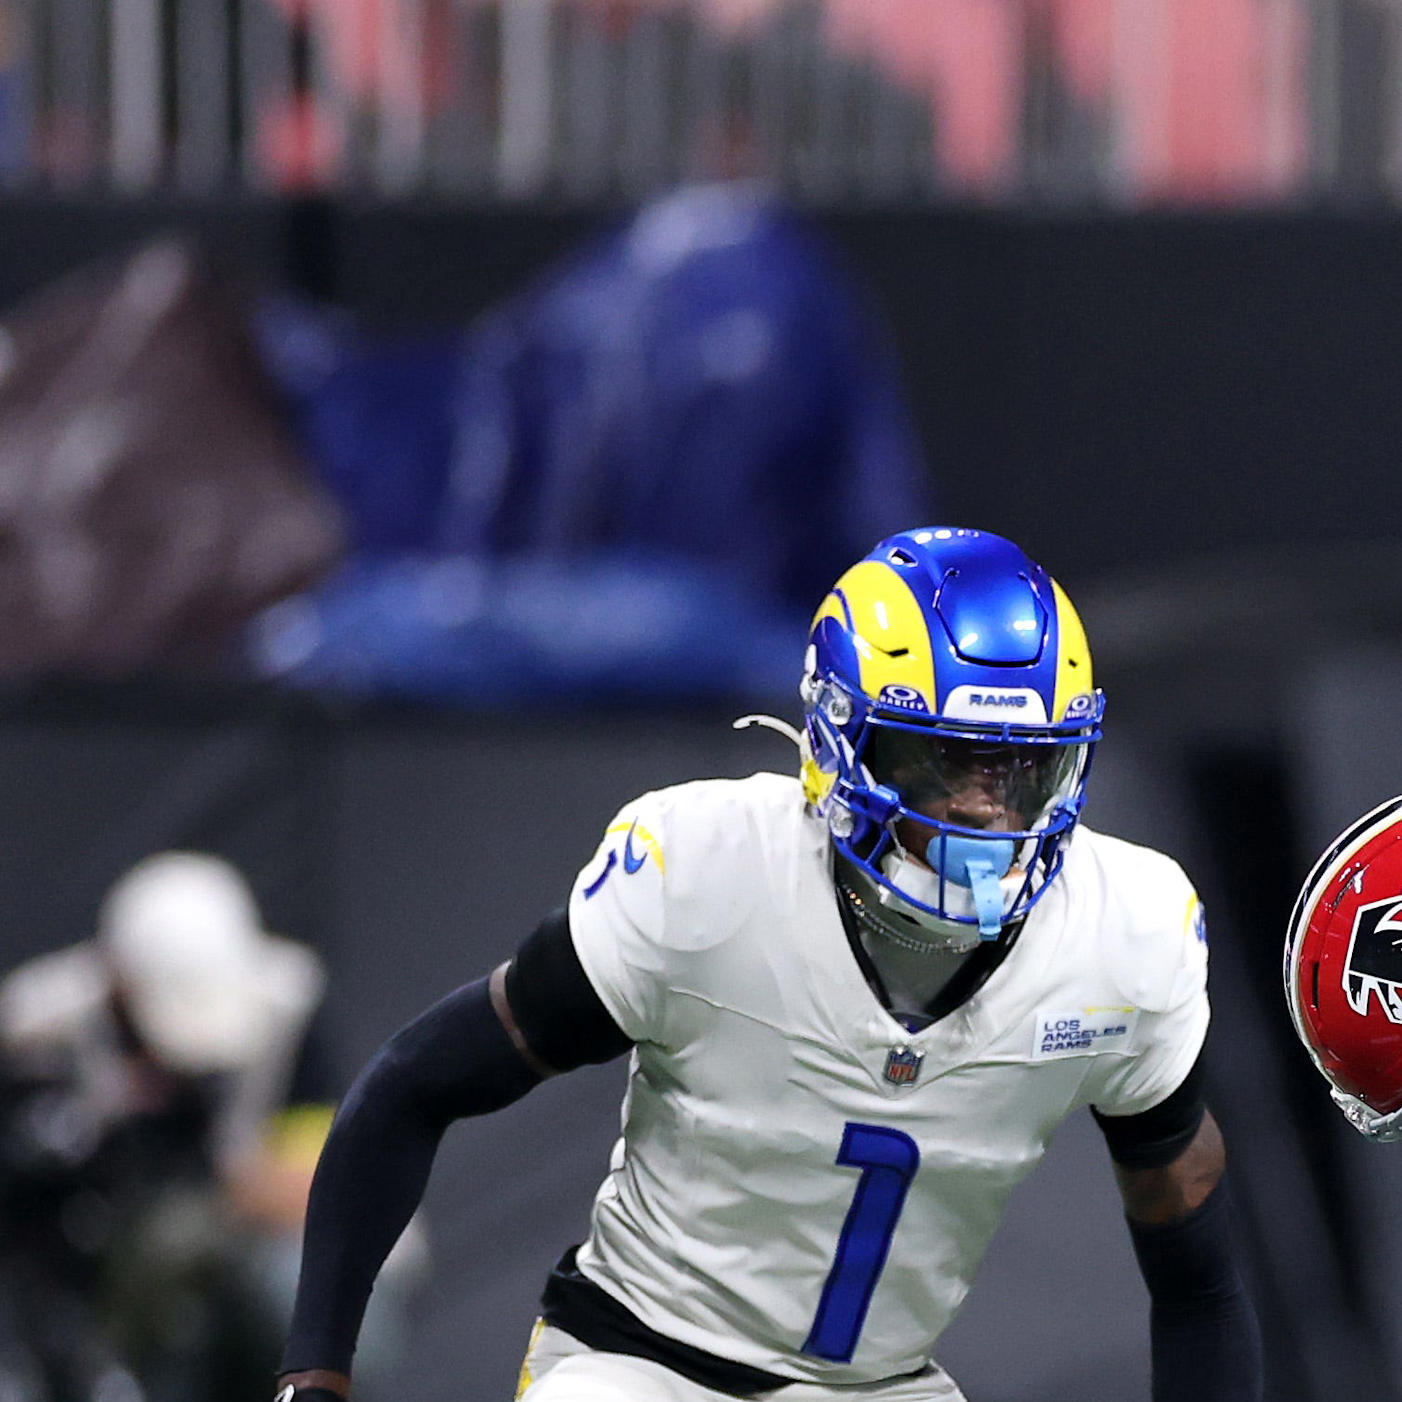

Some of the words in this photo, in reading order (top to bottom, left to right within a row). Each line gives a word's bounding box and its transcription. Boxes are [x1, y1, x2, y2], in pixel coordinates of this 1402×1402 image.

[969, 694, 1028, 709] RAMS
[1044, 1019, 1081, 1033] LOS
[1042, 1025, 1127, 1044] ANGELES
[1041, 1039, 1092, 1053] RAMS
[801, 1121, 920, 1365] 1
